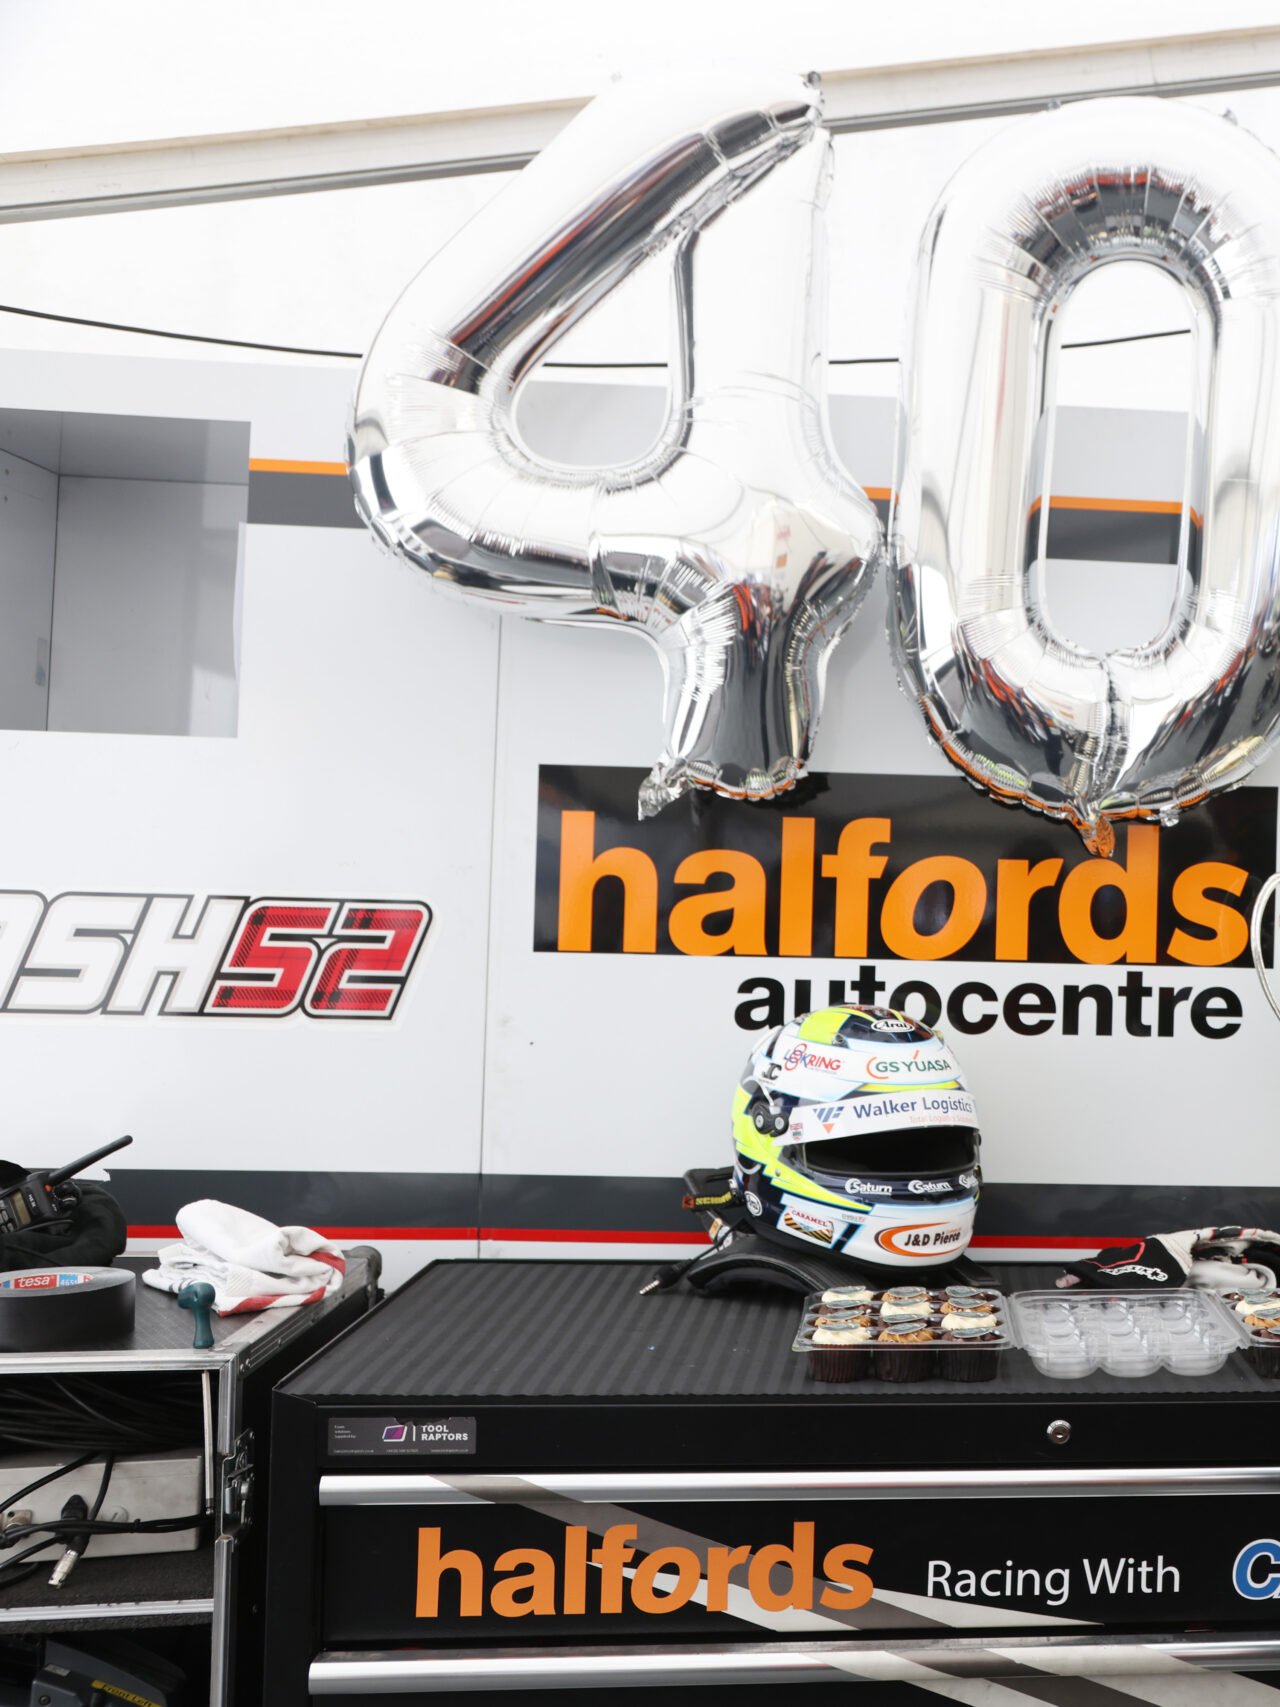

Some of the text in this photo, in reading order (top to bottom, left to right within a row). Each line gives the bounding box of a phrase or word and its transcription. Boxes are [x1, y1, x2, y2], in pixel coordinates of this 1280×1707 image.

[556, 810, 1250, 967] halfords
[734, 965, 1243, 1039] autocentre
[875, 1059, 952, 1073] GS YUASA
[853, 1096, 973, 1120] Walker Logistics
[850, 1180, 893, 1194] Saturn
[912, 1181, 953, 1193] Saturn
[904, 1233, 930, 1247] J&D
[933, 1231, 961, 1246] Pierce
[18, 1276, 51, 1288] tesa
[421, 1424, 449, 1433] TOOL
[421, 1433, 469, 1441] RAPTORS
[415, 1521, 875, 1619] halfords
[927, 1560, 1071, 1606] Racing
[1082, 1556, 1181, 1595] With
